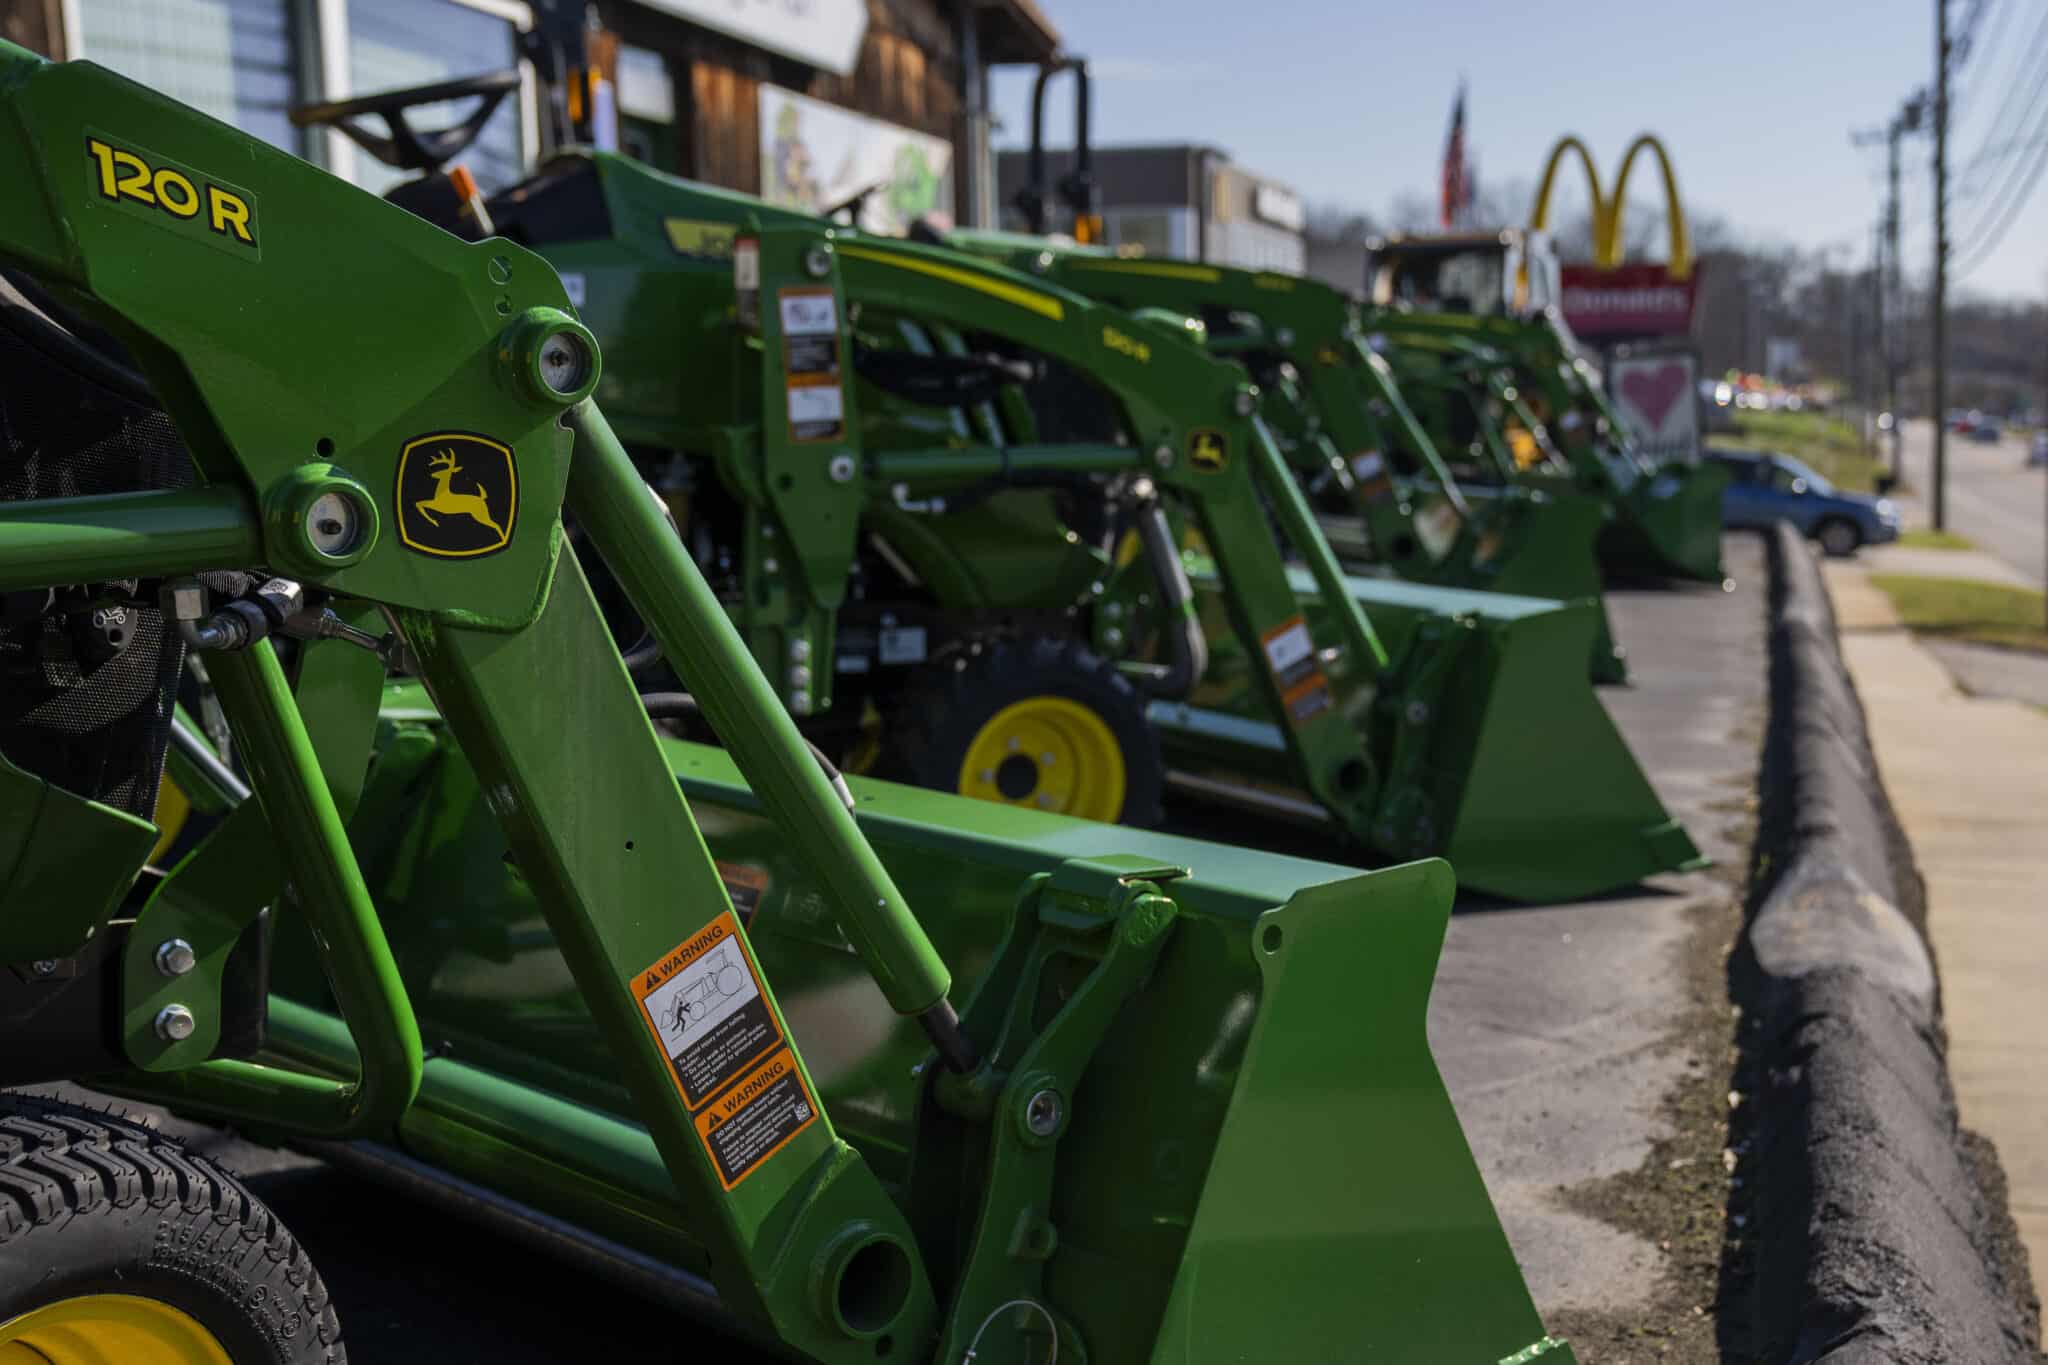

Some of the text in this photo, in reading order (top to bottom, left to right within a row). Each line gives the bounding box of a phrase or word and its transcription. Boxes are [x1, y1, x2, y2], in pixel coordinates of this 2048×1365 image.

[87, 137, 258, 248] 120 R
[659, 924, 723, 977] WARNING
[723, 1062, 784, 1113] WARNING
